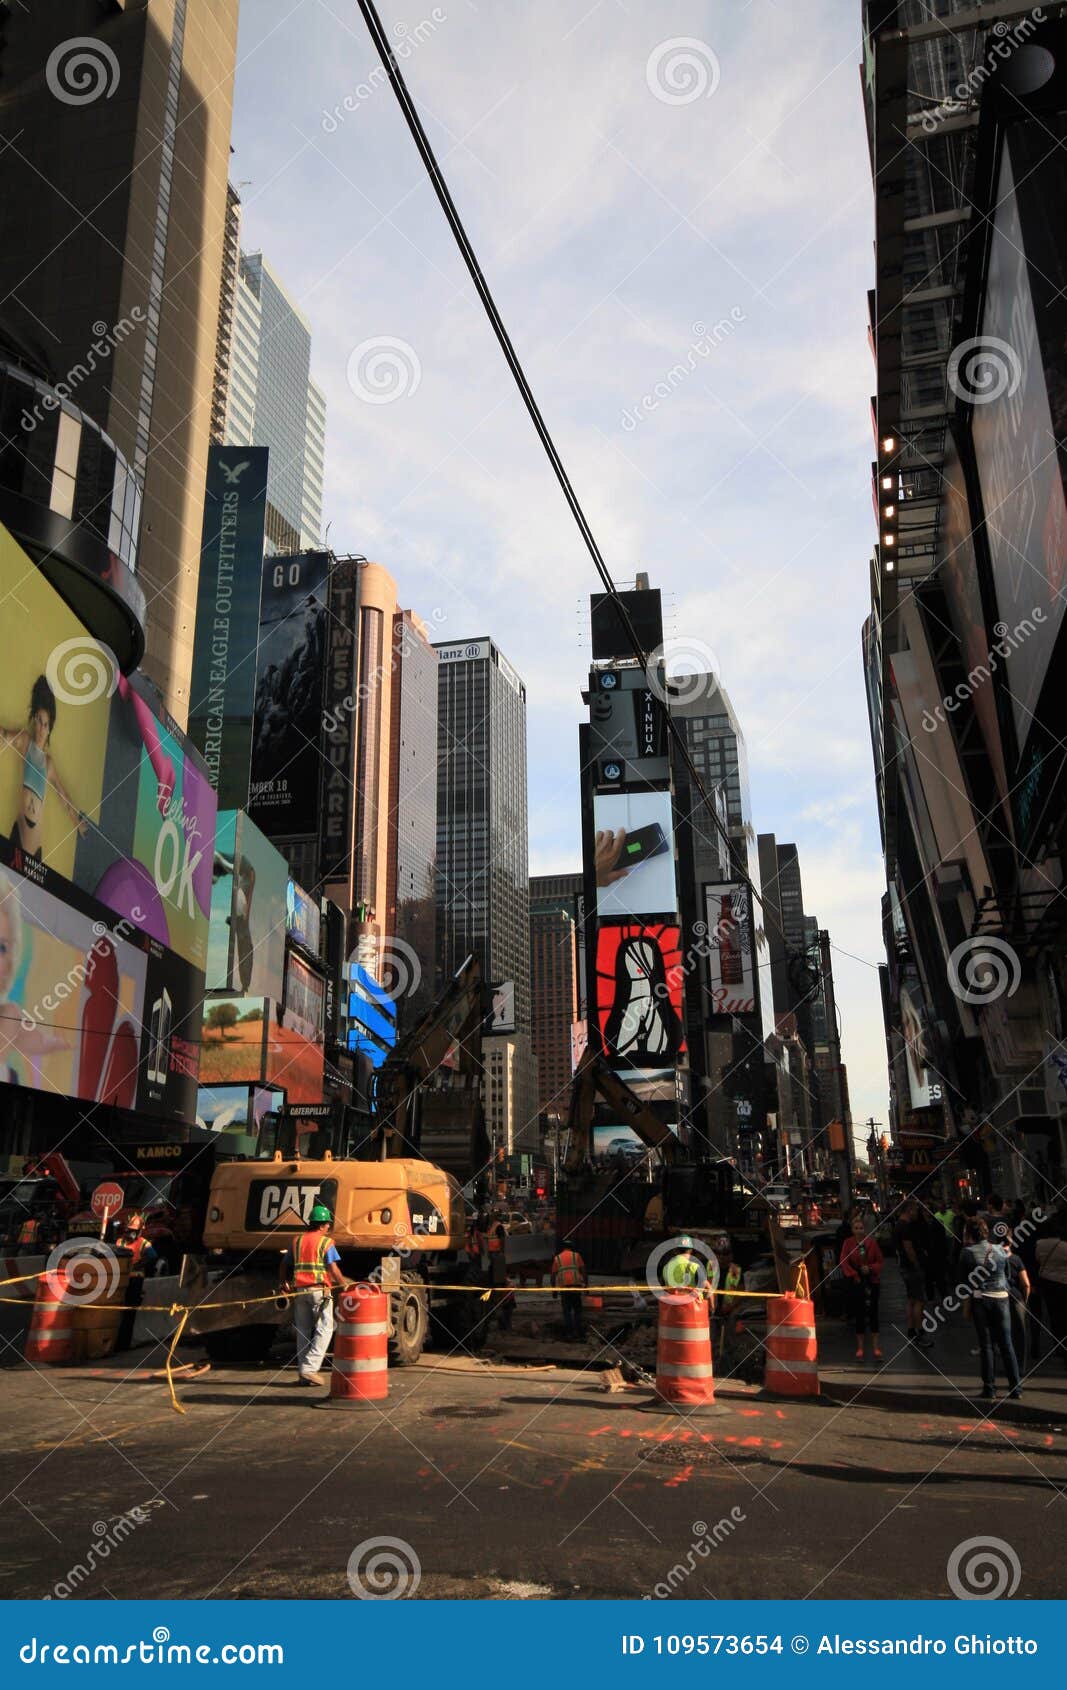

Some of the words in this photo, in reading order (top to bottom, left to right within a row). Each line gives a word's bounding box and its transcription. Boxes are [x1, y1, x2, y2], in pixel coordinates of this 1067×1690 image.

[216, 491, 240, 614] OUTFITTERS
[272, 562, 300, 588] GO
[210, 617, 231, 682] EAGLE
[332, 588, 352, 689] TIMES
[436, 648, 463, 660] ianz
[205, 688, 225, 793] MERICAN
[644, 691, 655, 754] XINHUA
[156, 782, 202, 838] Feeling
[154, 819, 203, 920] OK
[136, 1145, 182, 1159] KAMCO
[95, 1193, 121, 1206] STOP
[259, 1184, 321, 1227] CAT
